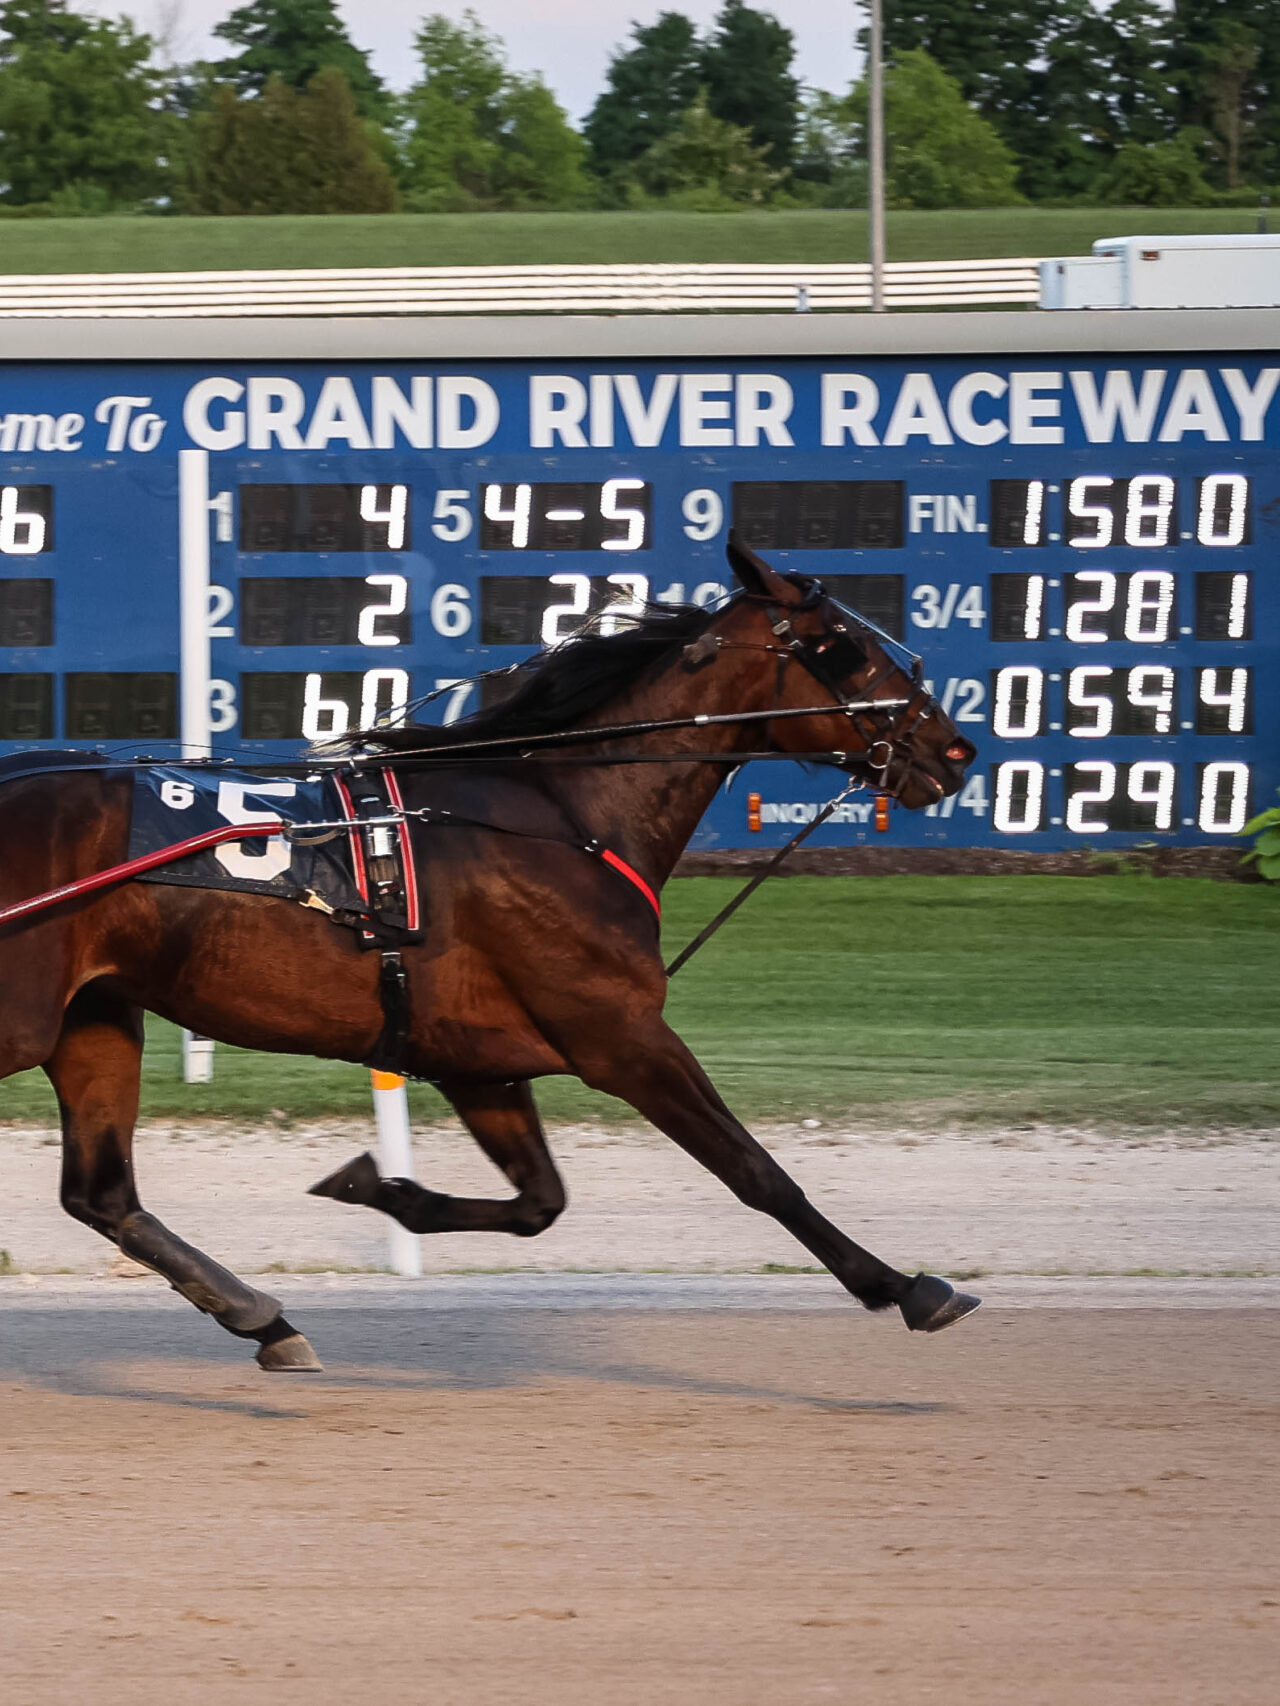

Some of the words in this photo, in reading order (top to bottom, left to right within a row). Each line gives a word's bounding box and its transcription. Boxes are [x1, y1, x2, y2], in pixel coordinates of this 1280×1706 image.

[95, 395, 166, 452] To
[181, 376, 500, 450] GRAND
[529, 373, 795, 447] RIVER
[821, 368, 1280, 446] RACEWAY
[207, 491, 233, 542] 1
[359, 484, 408, 549] 4
[431, 489, 473, 542] 5
[484, 477, 646, 551] 4-5
[681, 488, 723, 541] 9
[909, 494, 988, 533] FIN.
[206, 585, 235, 638] 2
[357, 574, 408, 646] 2
[430, 583, 472, 637] 6
[910, 583, 986, 629] 3/4
[208, 679, 238, 732] 3
[301, 668, 410, 742] 60
[434, 678, 475, 727] 7
[160, 780, 195, 810] 6
[215, 782, 297, 881] 5
